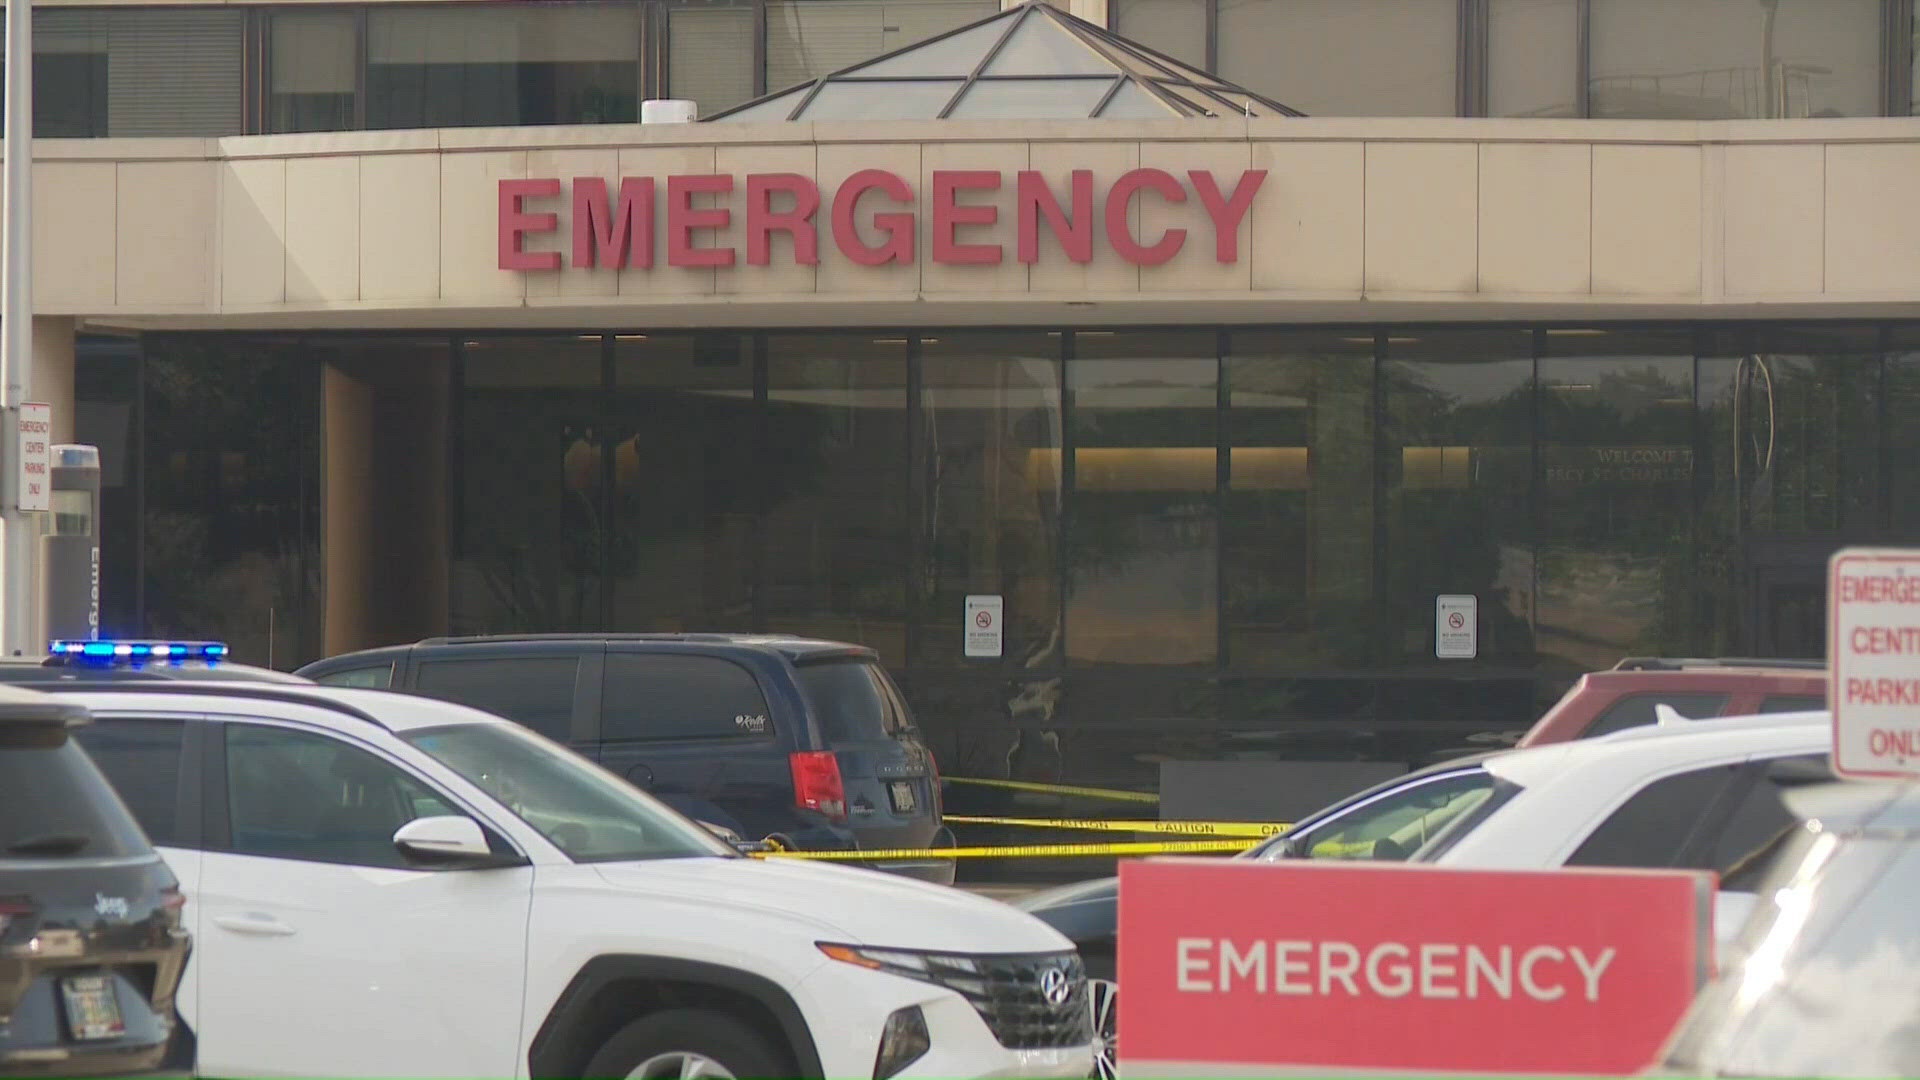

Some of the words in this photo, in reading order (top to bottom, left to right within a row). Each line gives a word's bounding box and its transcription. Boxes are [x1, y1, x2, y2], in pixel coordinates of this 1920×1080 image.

[497, 168, 1268, 272] EMERGENCY
[20, 421, 48, 433] EMERGENCY
[25, 442, 45, 453] CENTER
[1597, 449, 1674, 464] WELCOME
[25, 462, 45, 474] PARKING
[28, 483, 41, 495] ONLY
[1851, 626, 1920, 655] CENT
[1154, 823, 1214, 833] CAUTION
[1177, 937, 1616, 1002] EMERGENCY
